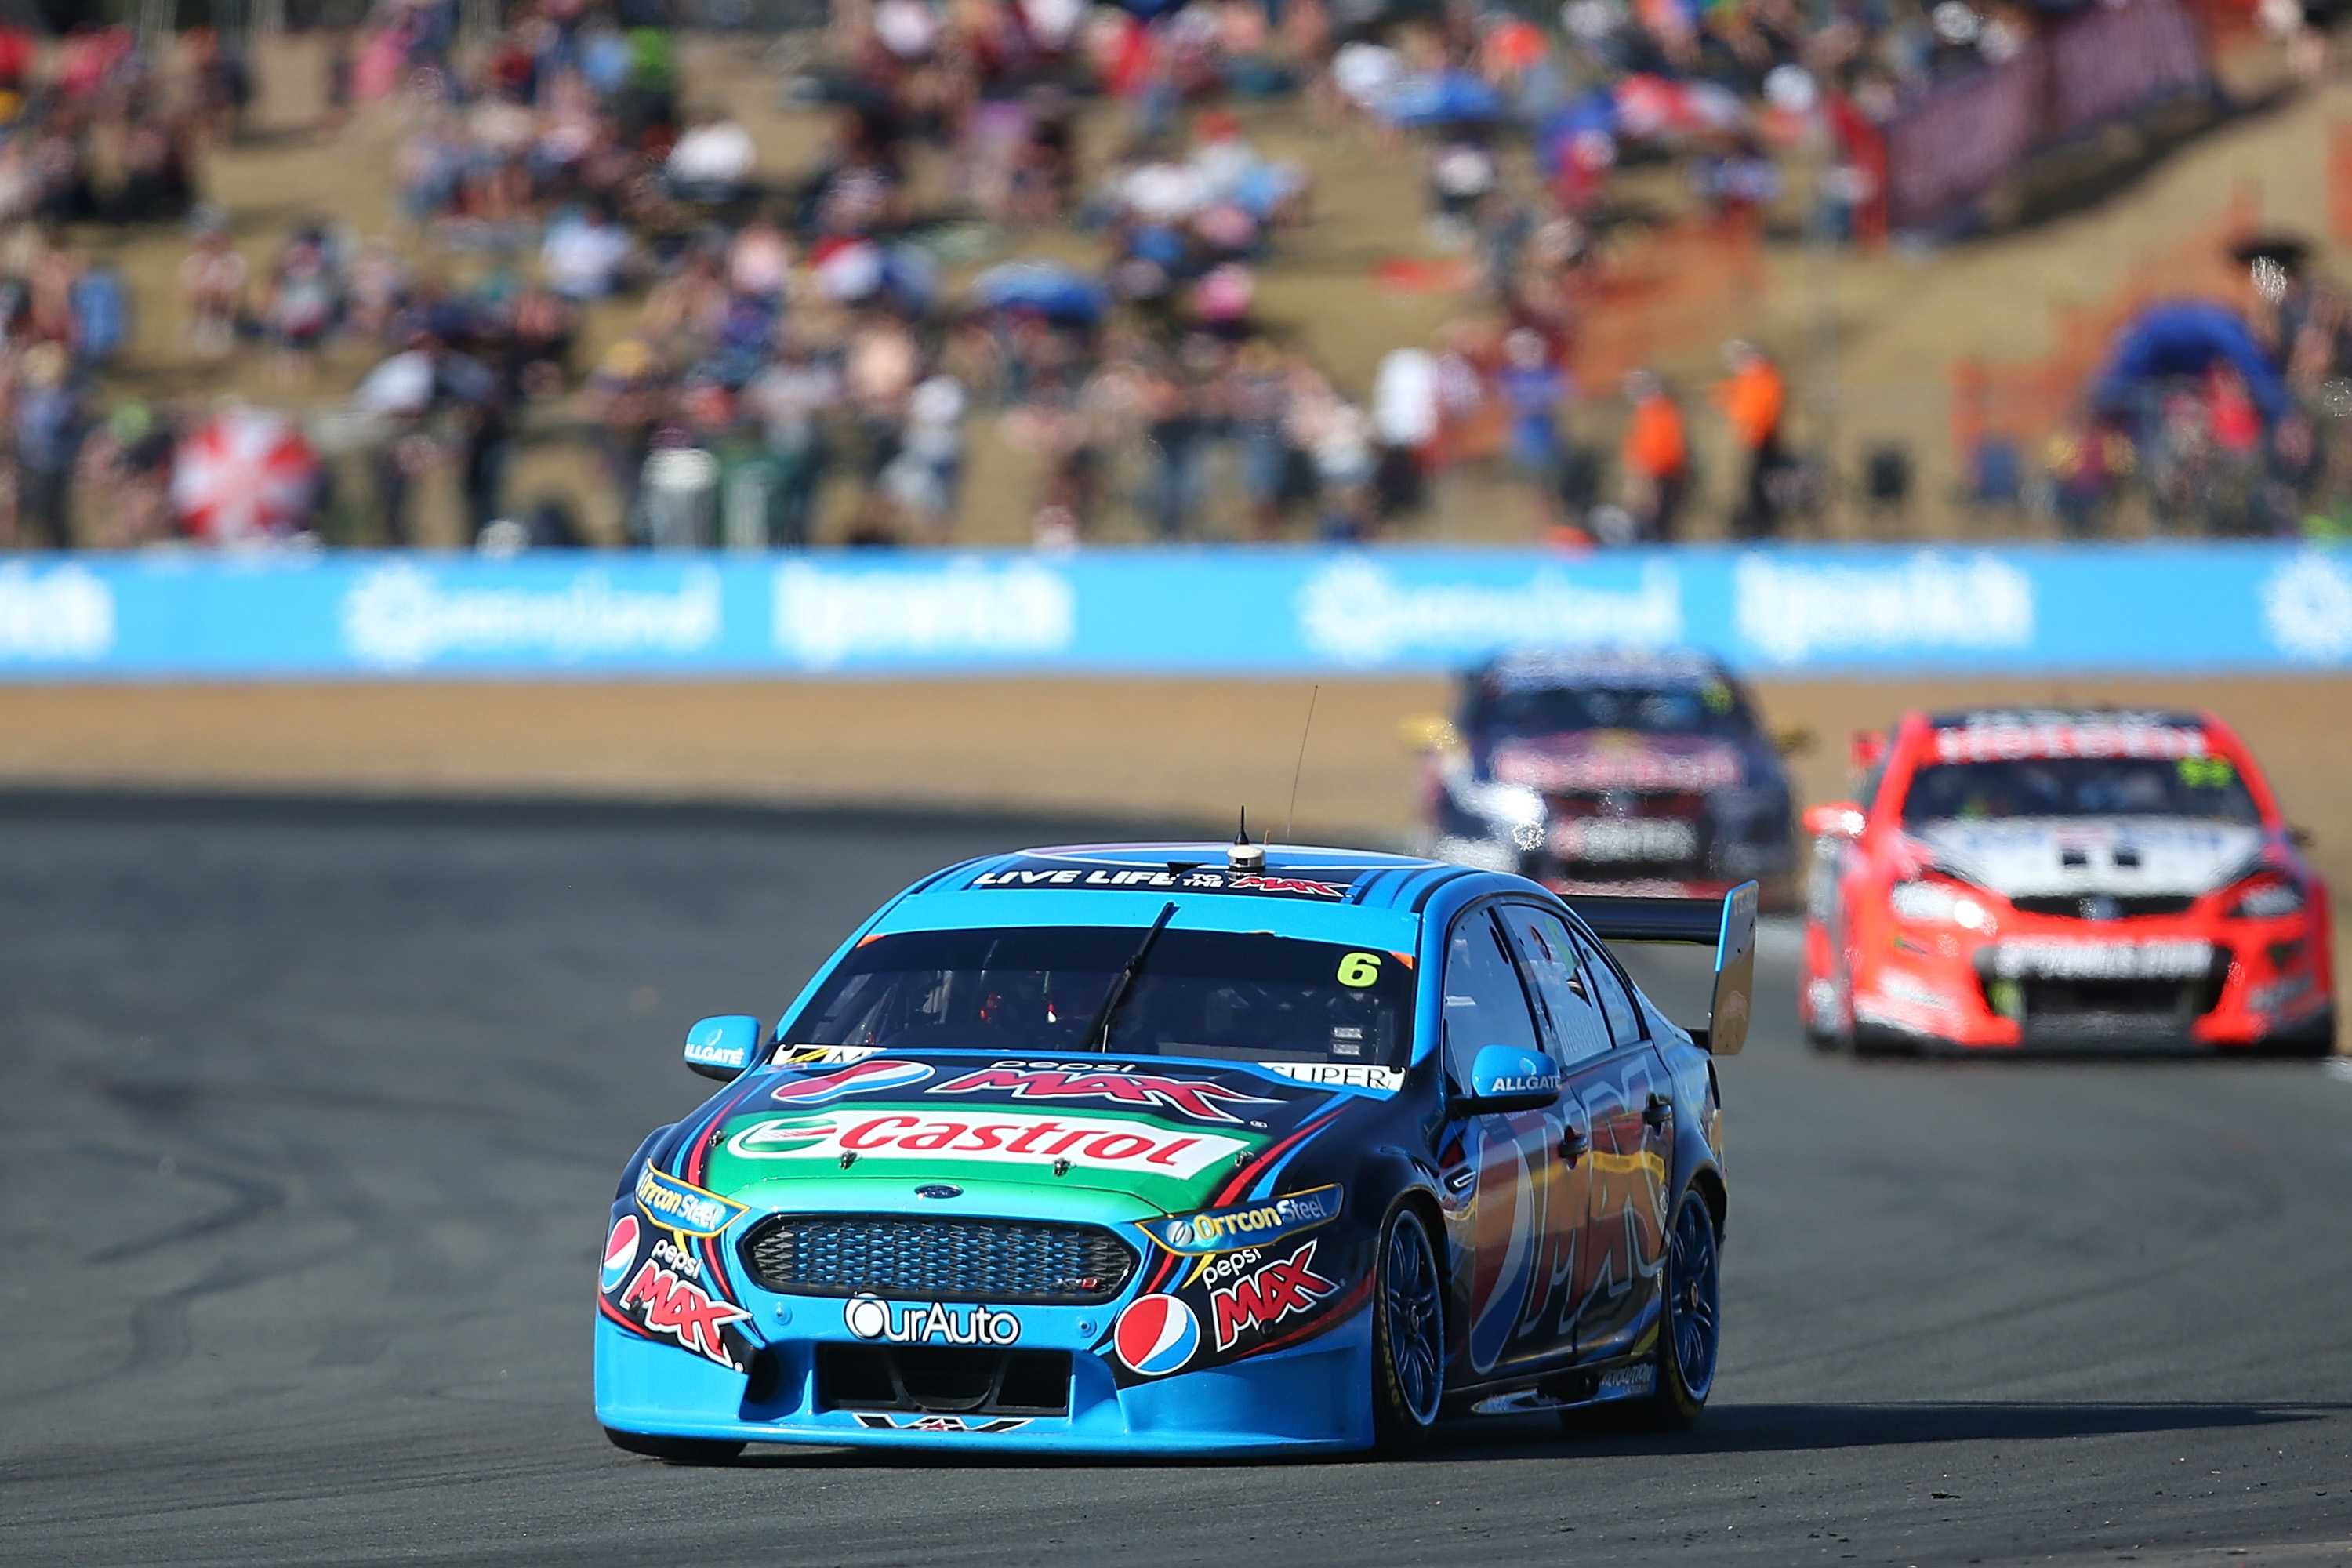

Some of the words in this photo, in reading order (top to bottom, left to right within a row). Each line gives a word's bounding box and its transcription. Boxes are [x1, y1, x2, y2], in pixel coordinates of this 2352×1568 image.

[973, 870, 1081, 884] LIVE
[1085, 870, 1179, 886] LIFE
[1182, 878, 1224, 887] THE
[1192, 873, 1221, 881] TO
[1228, 876, 1353, 898] MAX
[1337, 953, 1381, 987] 6
[684, 1042, 745, 1065] LLGATE
[990, 1060, 1136, 1073] pepsi
[924, 1068, 1287, 1124] MAX
[839, 1116, 1203, 1166] Castrol
[652, 1238, 704, 1279] pepsi
[1202, 1247, 1261, 1290] pepsi
[1210, 1237, 1341, 1352] MAX
[619, 1257, 753, 1368] MAX
[845, 1294, 1019, 1345] OurAuto
